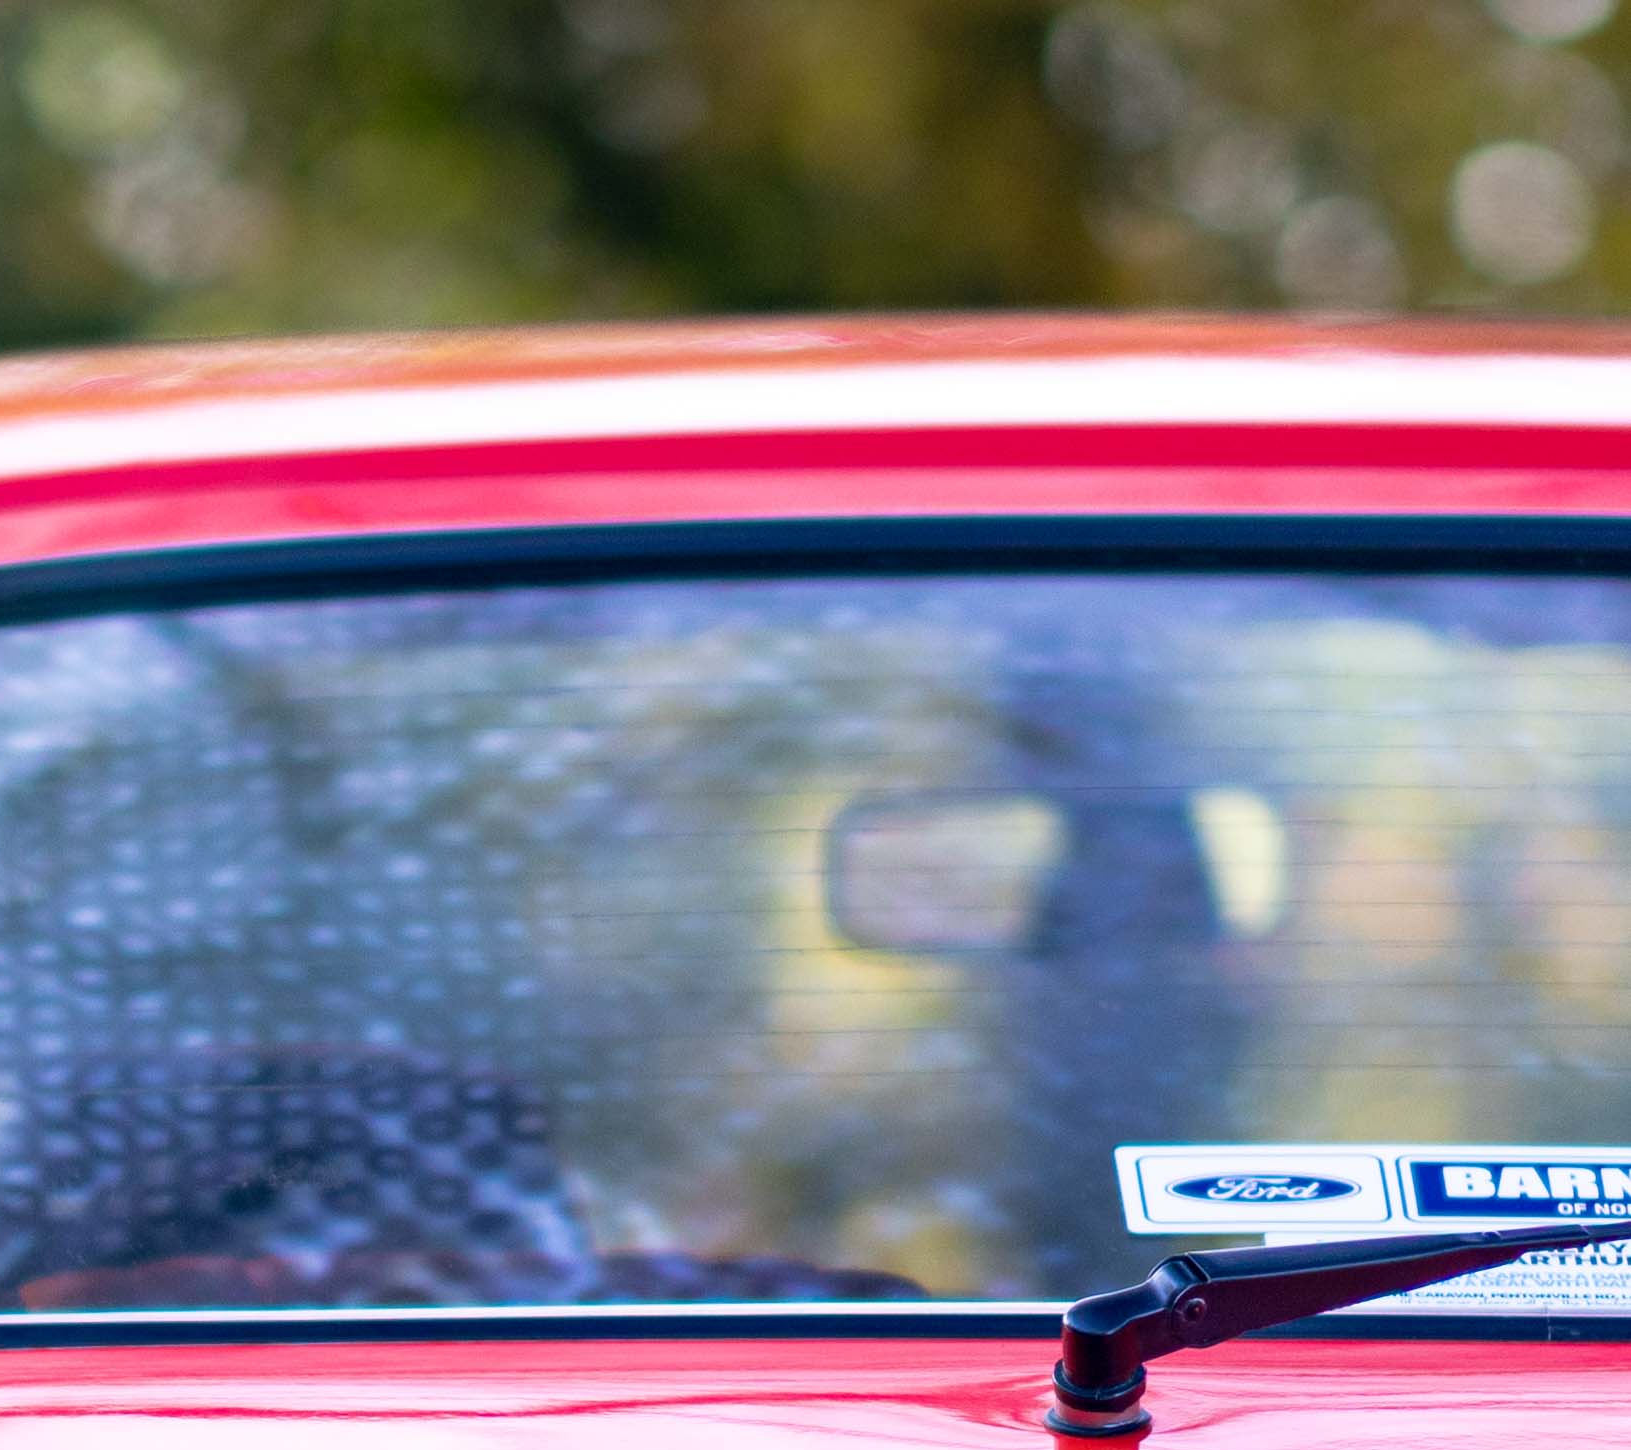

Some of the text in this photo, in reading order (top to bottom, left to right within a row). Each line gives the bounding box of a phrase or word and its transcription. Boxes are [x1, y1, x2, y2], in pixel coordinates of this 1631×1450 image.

[1208, 1177, 1320, 1200] Ford
[1557, 1202, 1631, 1217] OF NO
